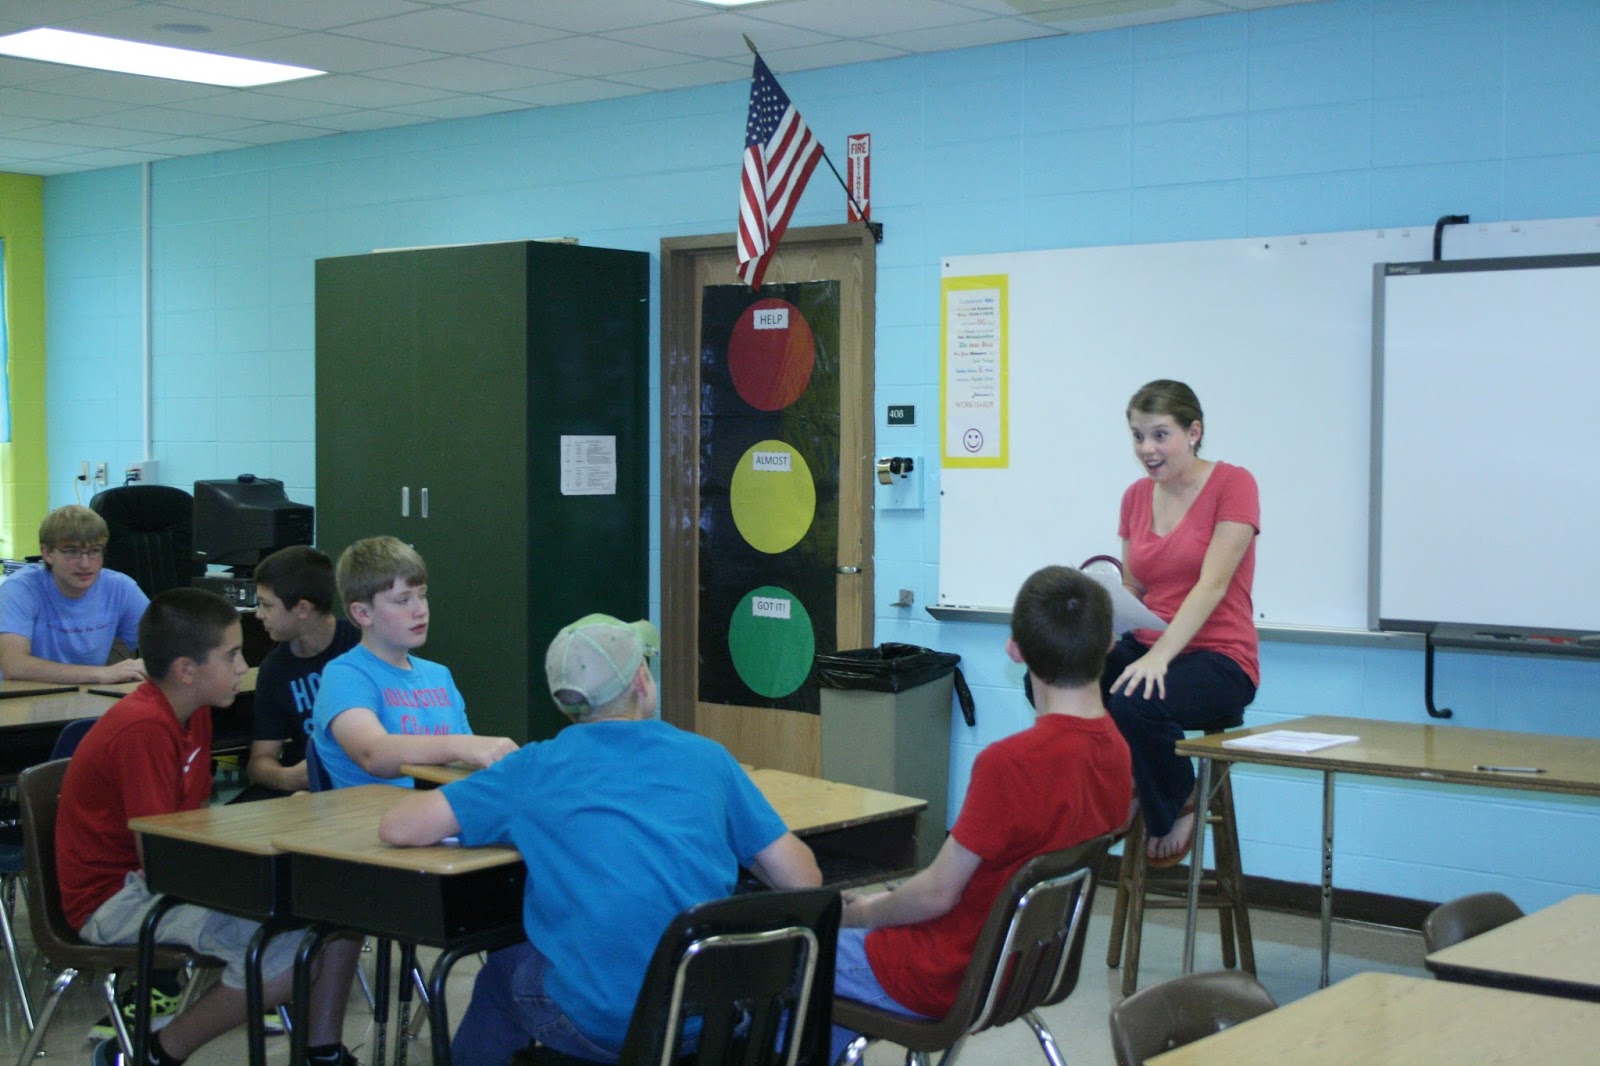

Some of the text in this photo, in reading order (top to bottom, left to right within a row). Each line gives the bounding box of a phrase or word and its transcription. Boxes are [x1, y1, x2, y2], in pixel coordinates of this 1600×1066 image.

[851, 142, 867, 154] FIRE
[760, 314, 783, 325] HELP
[889, 409, 905, 419] 408
[755, 455, 788, 466] ALMOST
[757, 601, 774, 611] GOT
